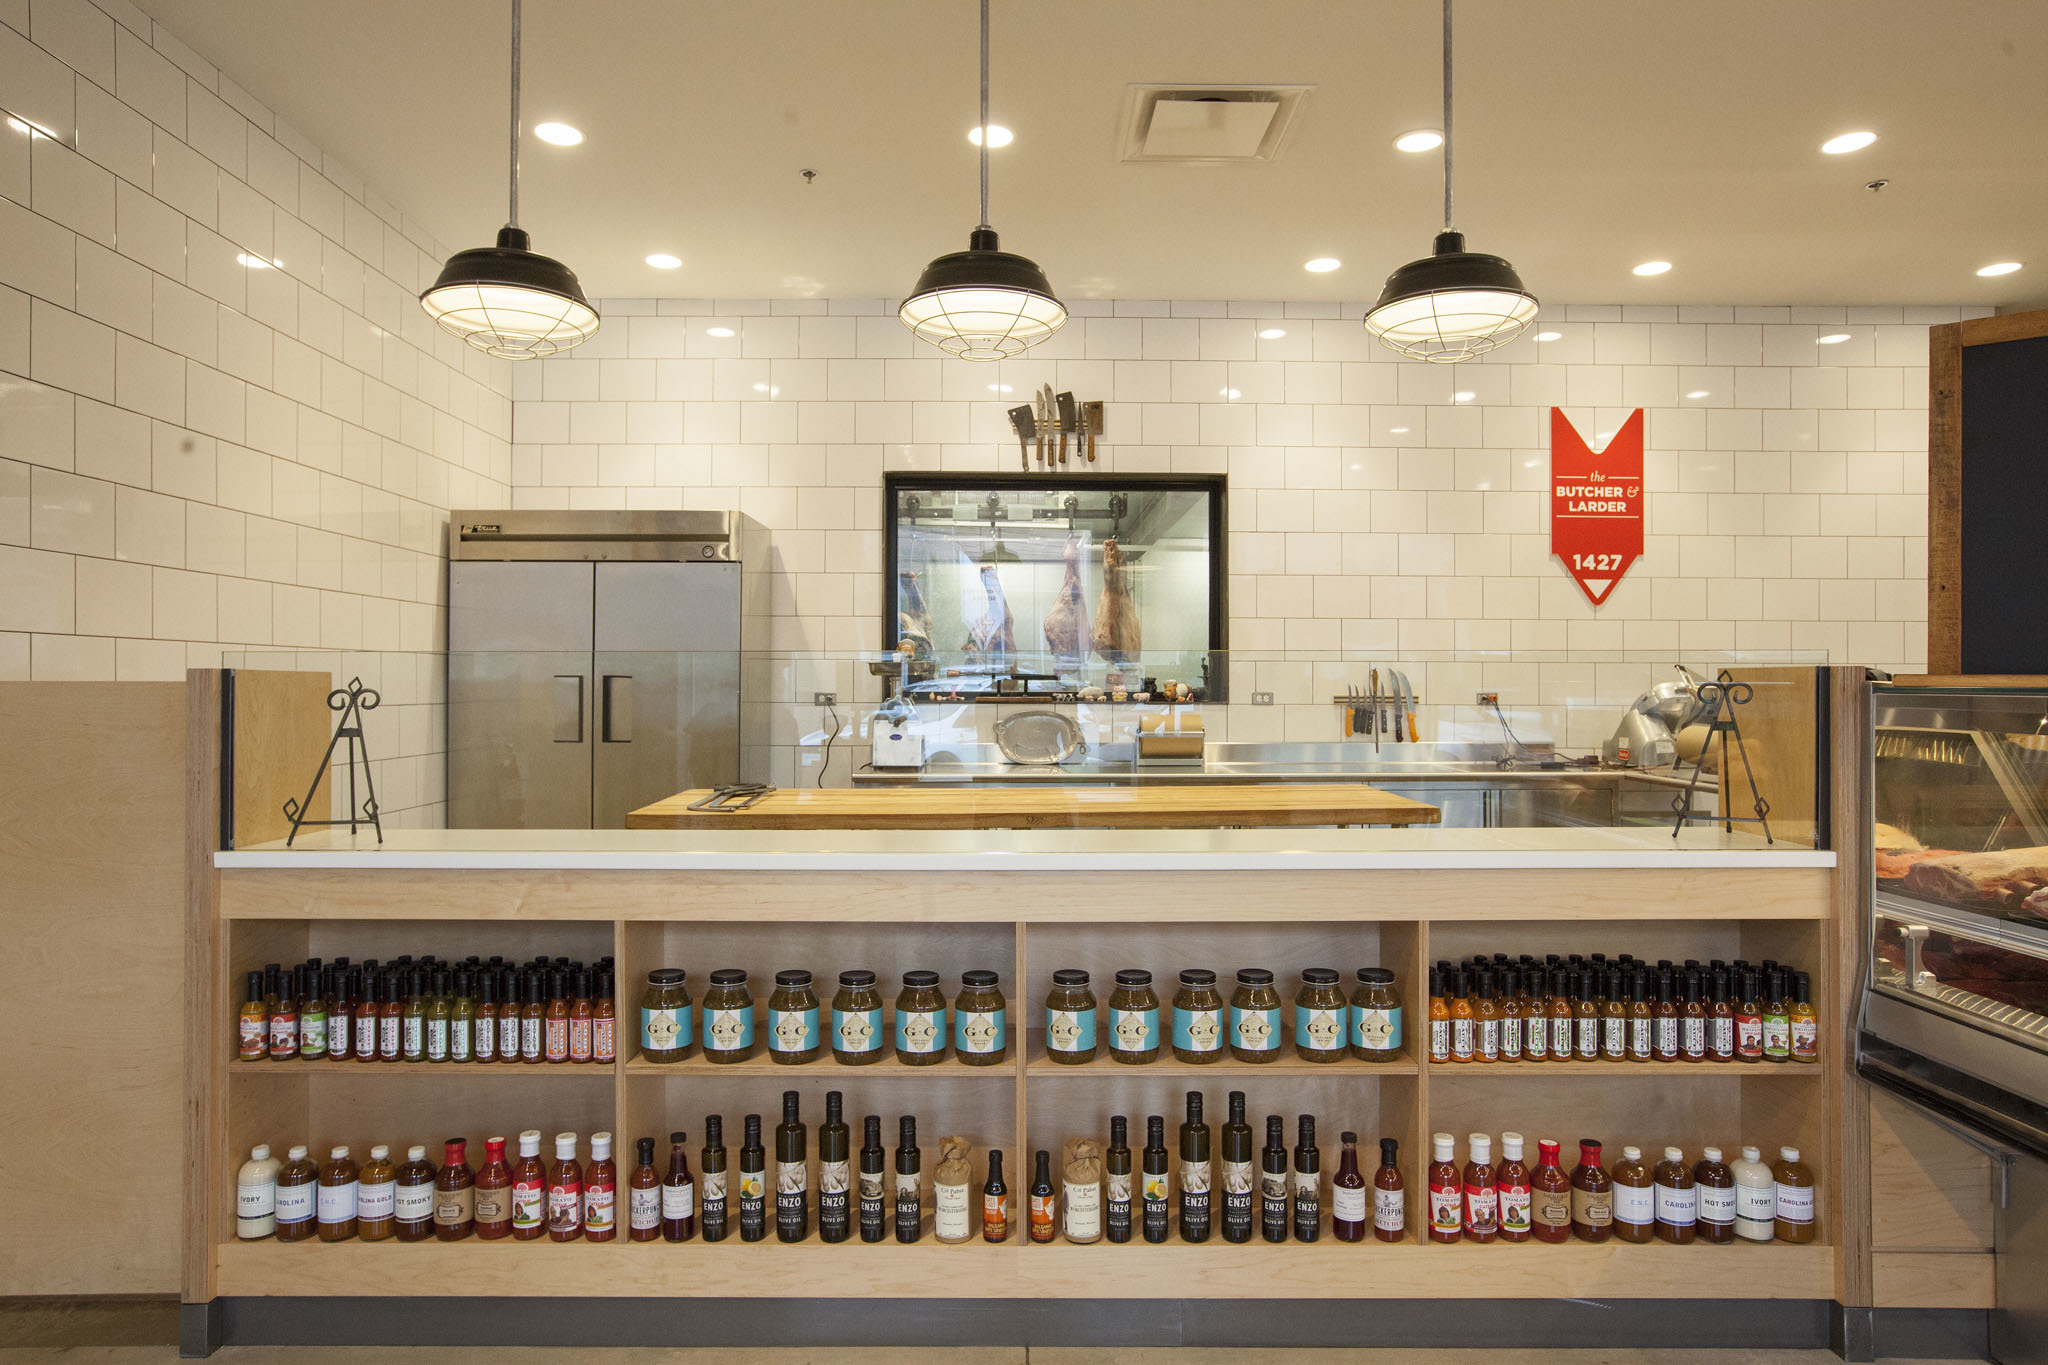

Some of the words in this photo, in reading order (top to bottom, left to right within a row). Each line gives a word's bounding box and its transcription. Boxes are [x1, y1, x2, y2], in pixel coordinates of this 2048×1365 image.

[1590, 470, 1605, 482] the
[1556, 486, 1623, 498] BUTCHER
[1626, 486, 1640, 498] &
[1568, 501, 1626, 512] LARDER
[1573, 554, 1622, 570] 1427
[406, 1196, 431, 1205] SMOKY
[778, 1197, 801, 1207] ENZO
[822, 1196, 845, 1207] ENZO
[1185, 1196, 1208, 1207] ENZO
[1228, 1197, 1250, 1207] ENZO
[1779, 1197, 1809, 1206] CAROLINA
[704, 1202, 724, 1211] ENZO
[742, 1202, 761, 1210] ENZO
[861, 1202, 880, 1211] ENZO
[898, 1204, 918, 1212] ENZO
[1110, 1204, 1129, 1212] ENZO
[1147, 1203, 1166, 1212] ENZO
[1265, 1202, 1284, 1211] ENZO
[1298, 1202, 1317, 1211] ENZO
